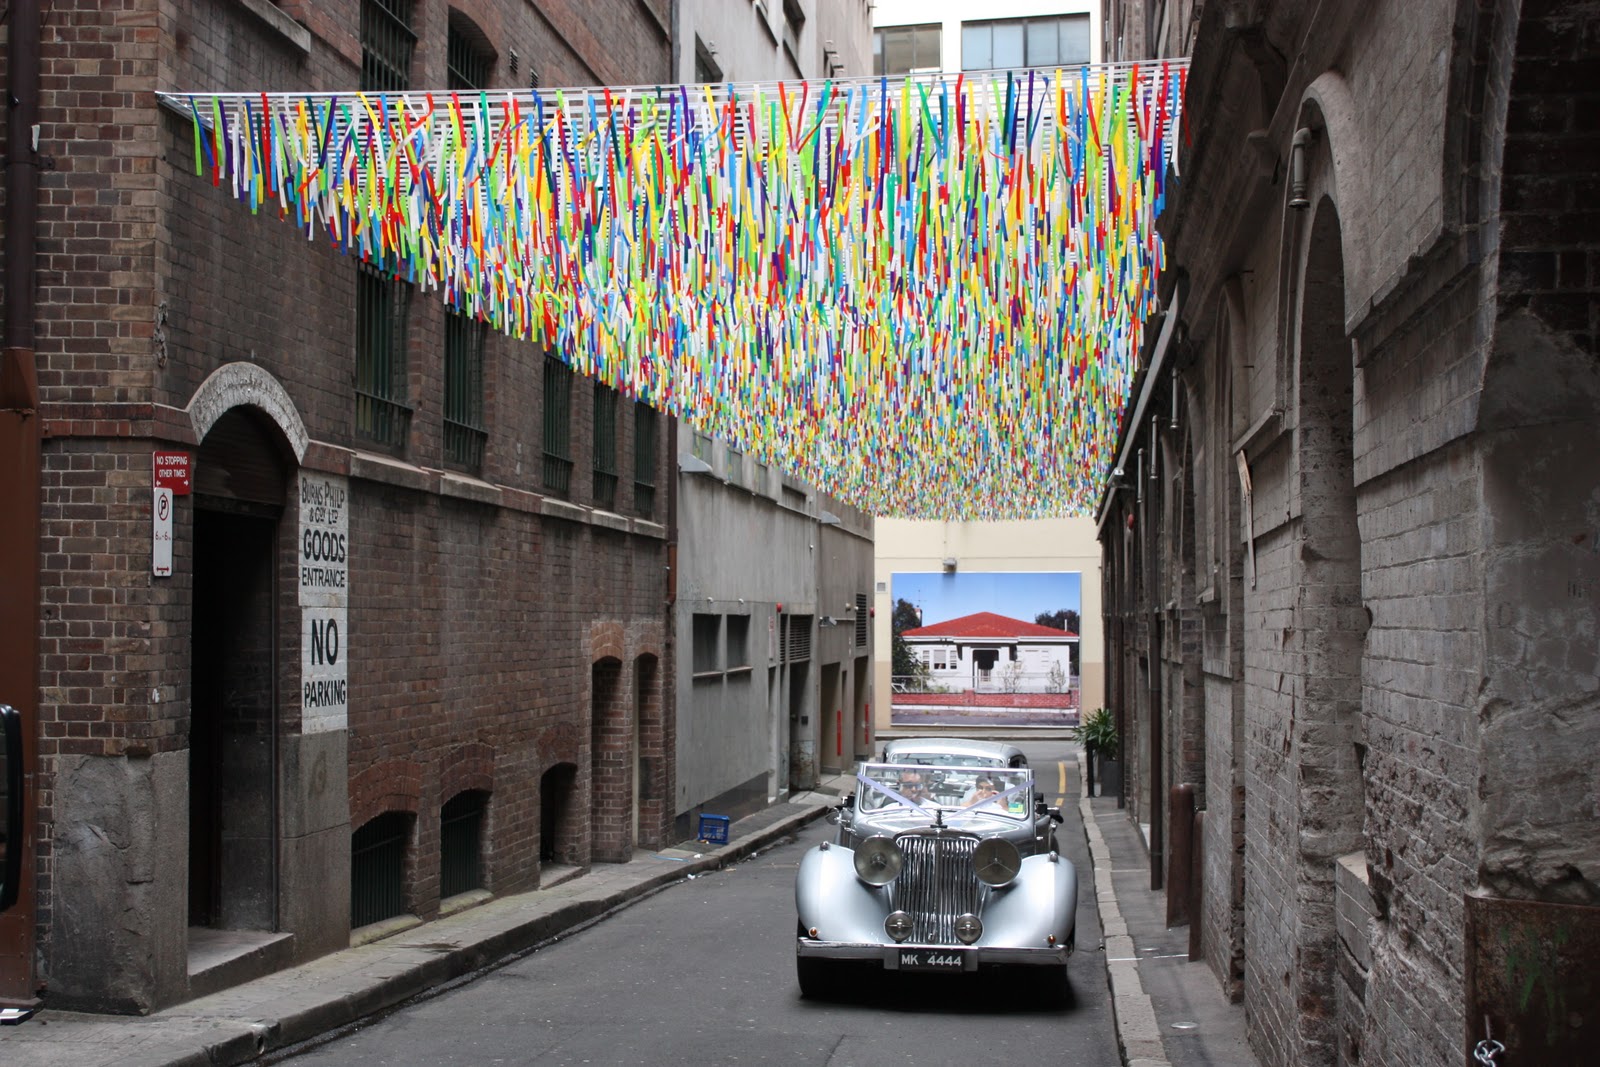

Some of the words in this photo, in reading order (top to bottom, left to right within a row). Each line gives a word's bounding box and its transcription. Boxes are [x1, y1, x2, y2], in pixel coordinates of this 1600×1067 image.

[156, 456, 164, 465] NO
[165, 456, 188, 465] STOPPING
[158, 469, 172, 478] OTHER
[174, 469, 186, 478] TIMES
[304, 528, 346, 564] GOODS
[302, 566, 346, 588] ENTRANCE
[311, 618, 338, 666] NO
[304, 680, 346, 708] PARKING
[902, 954, 918, 965] MK
[927, 955, 962, 966] 4444
